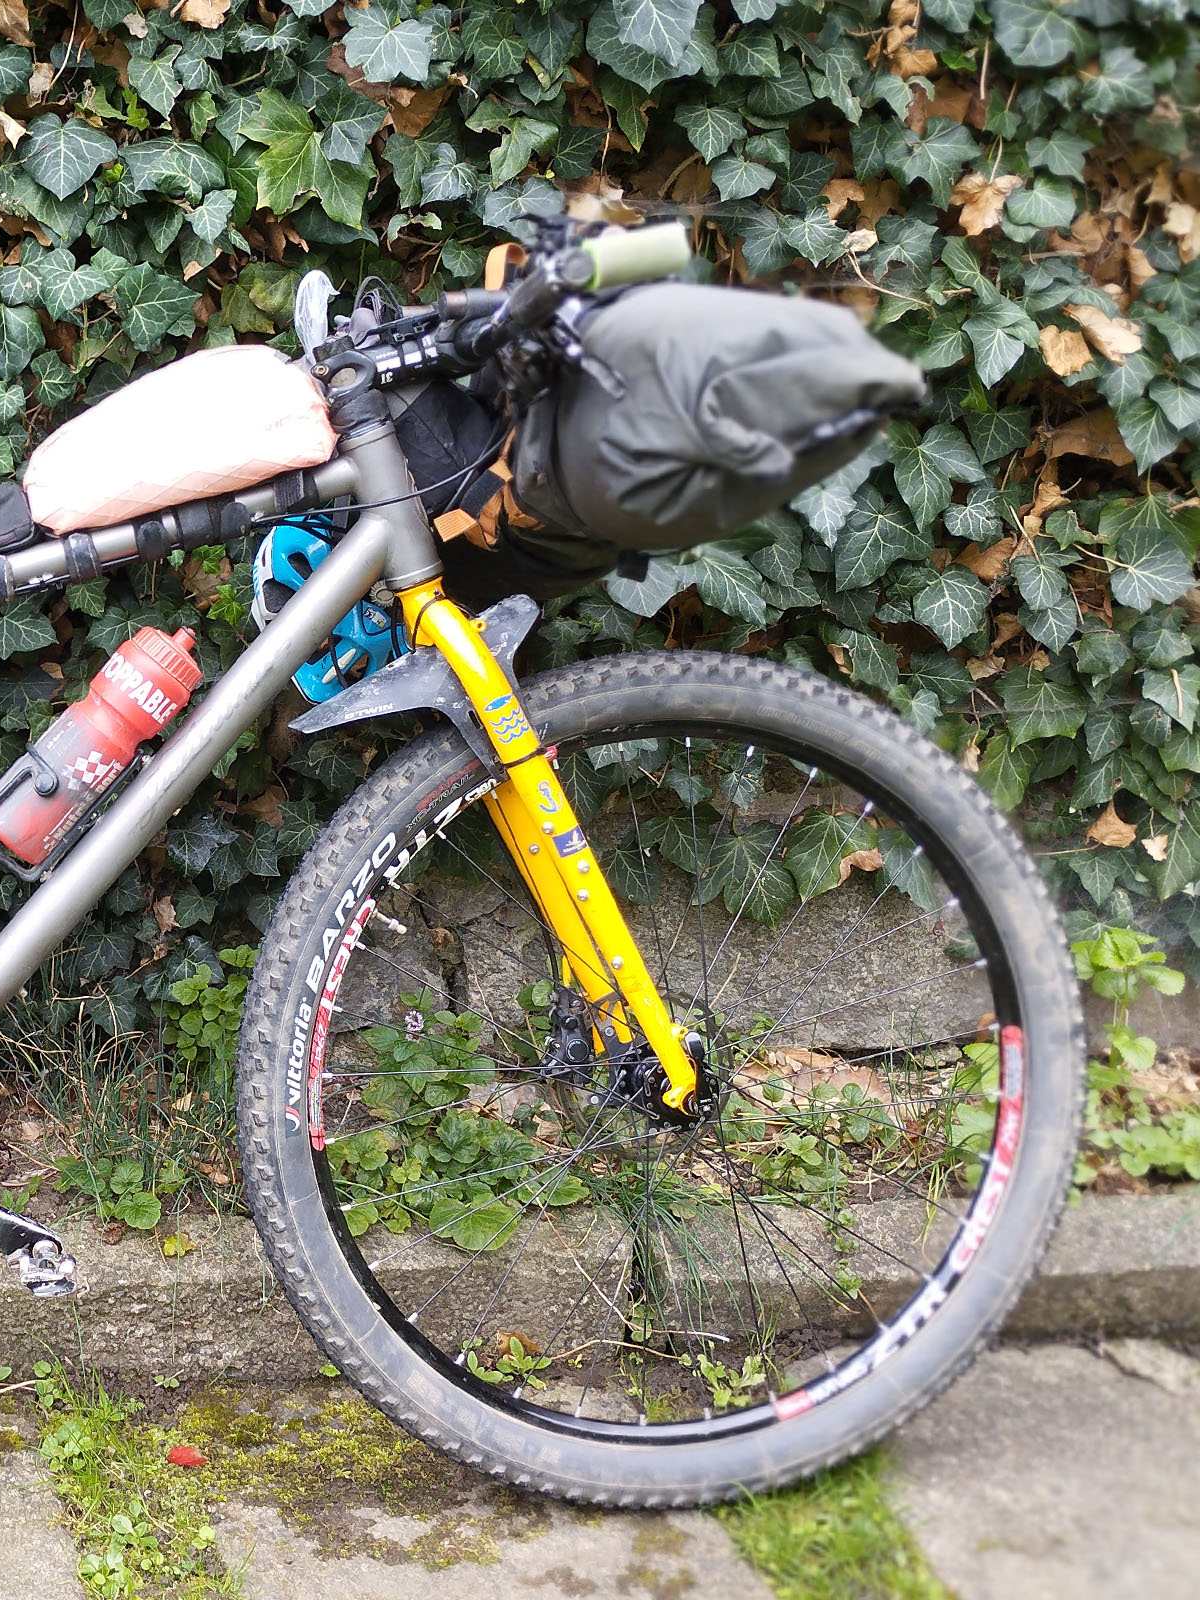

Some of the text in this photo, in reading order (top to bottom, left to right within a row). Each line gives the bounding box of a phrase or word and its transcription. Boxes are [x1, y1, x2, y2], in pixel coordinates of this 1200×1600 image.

[286, 832, 397, 1106] vittoria BARZO
[321, 898, 377, 1020] CREST
